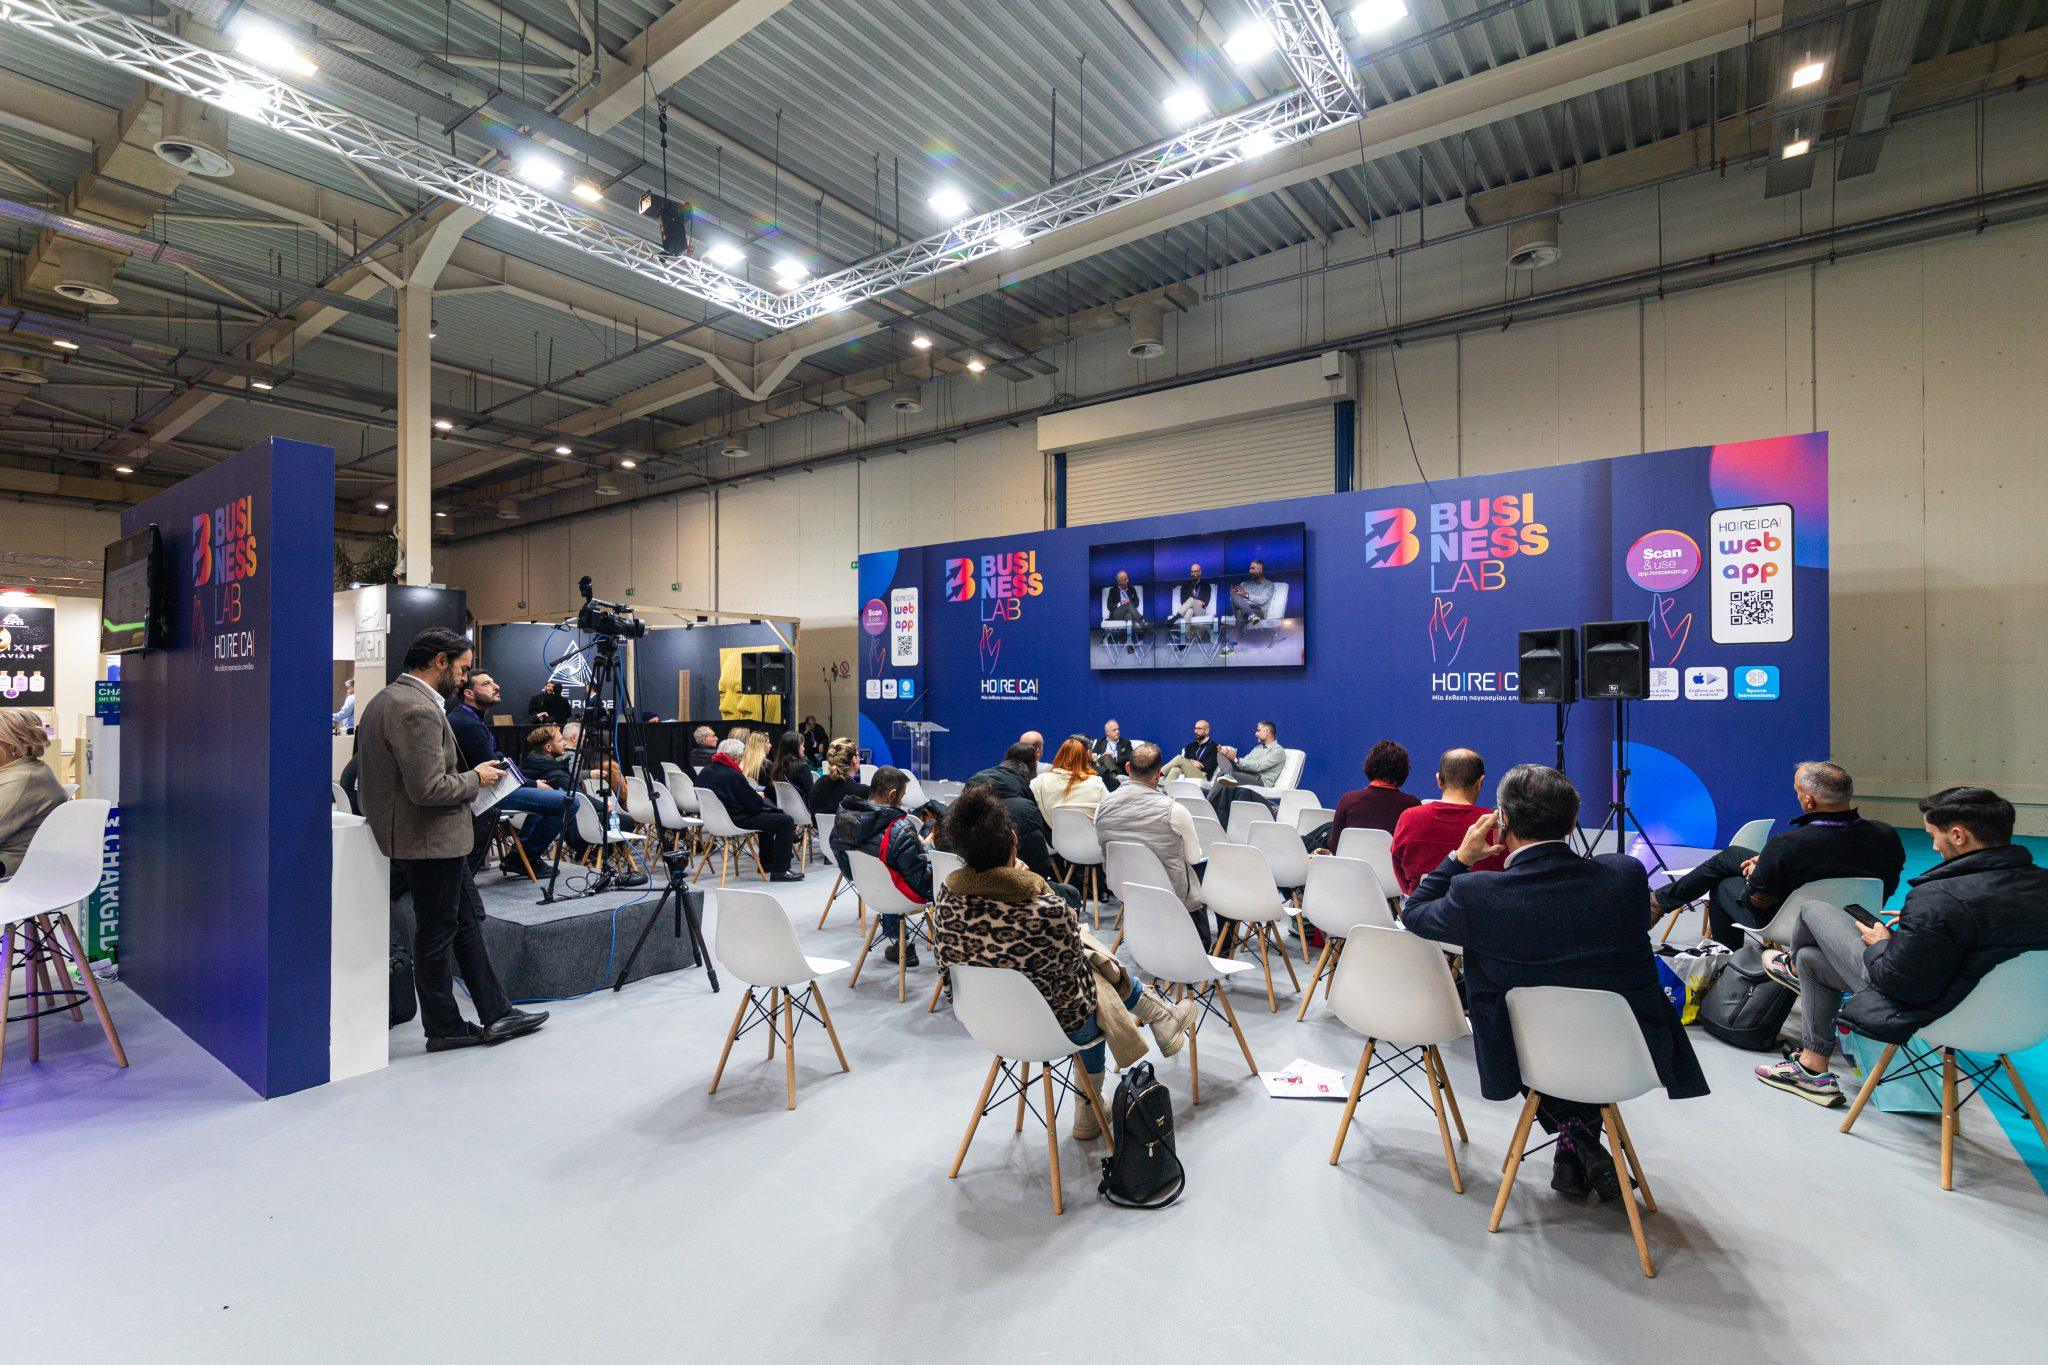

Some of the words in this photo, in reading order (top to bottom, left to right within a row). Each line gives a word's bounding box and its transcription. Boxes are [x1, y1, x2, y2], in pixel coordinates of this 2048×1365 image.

[214, 495, 253, 546] BUSI
[1430, 493, 1534, 533] BUSI
[1430, 523, 1550, 563] NESS
[1643, 548, 1682, 560] Scan
[1719, 532, 1781, 555] web
[214, 535, 257, 586] NESS
[981, 550, 1036, 577] BUSI
[1654, 560, 1677, 570] use
[1722, 562, 1779, 585] app
[981, 572, 1044, 600] NESS
[1430, 560, 1506, 594] LAB
[214, 582, 241, 625] LAB
[894, 602, 915, 615] web
[981, 597, 1022, 622] LAB
[895, 620, 914, 632] app
[98, 688, 121, 696] CHA
